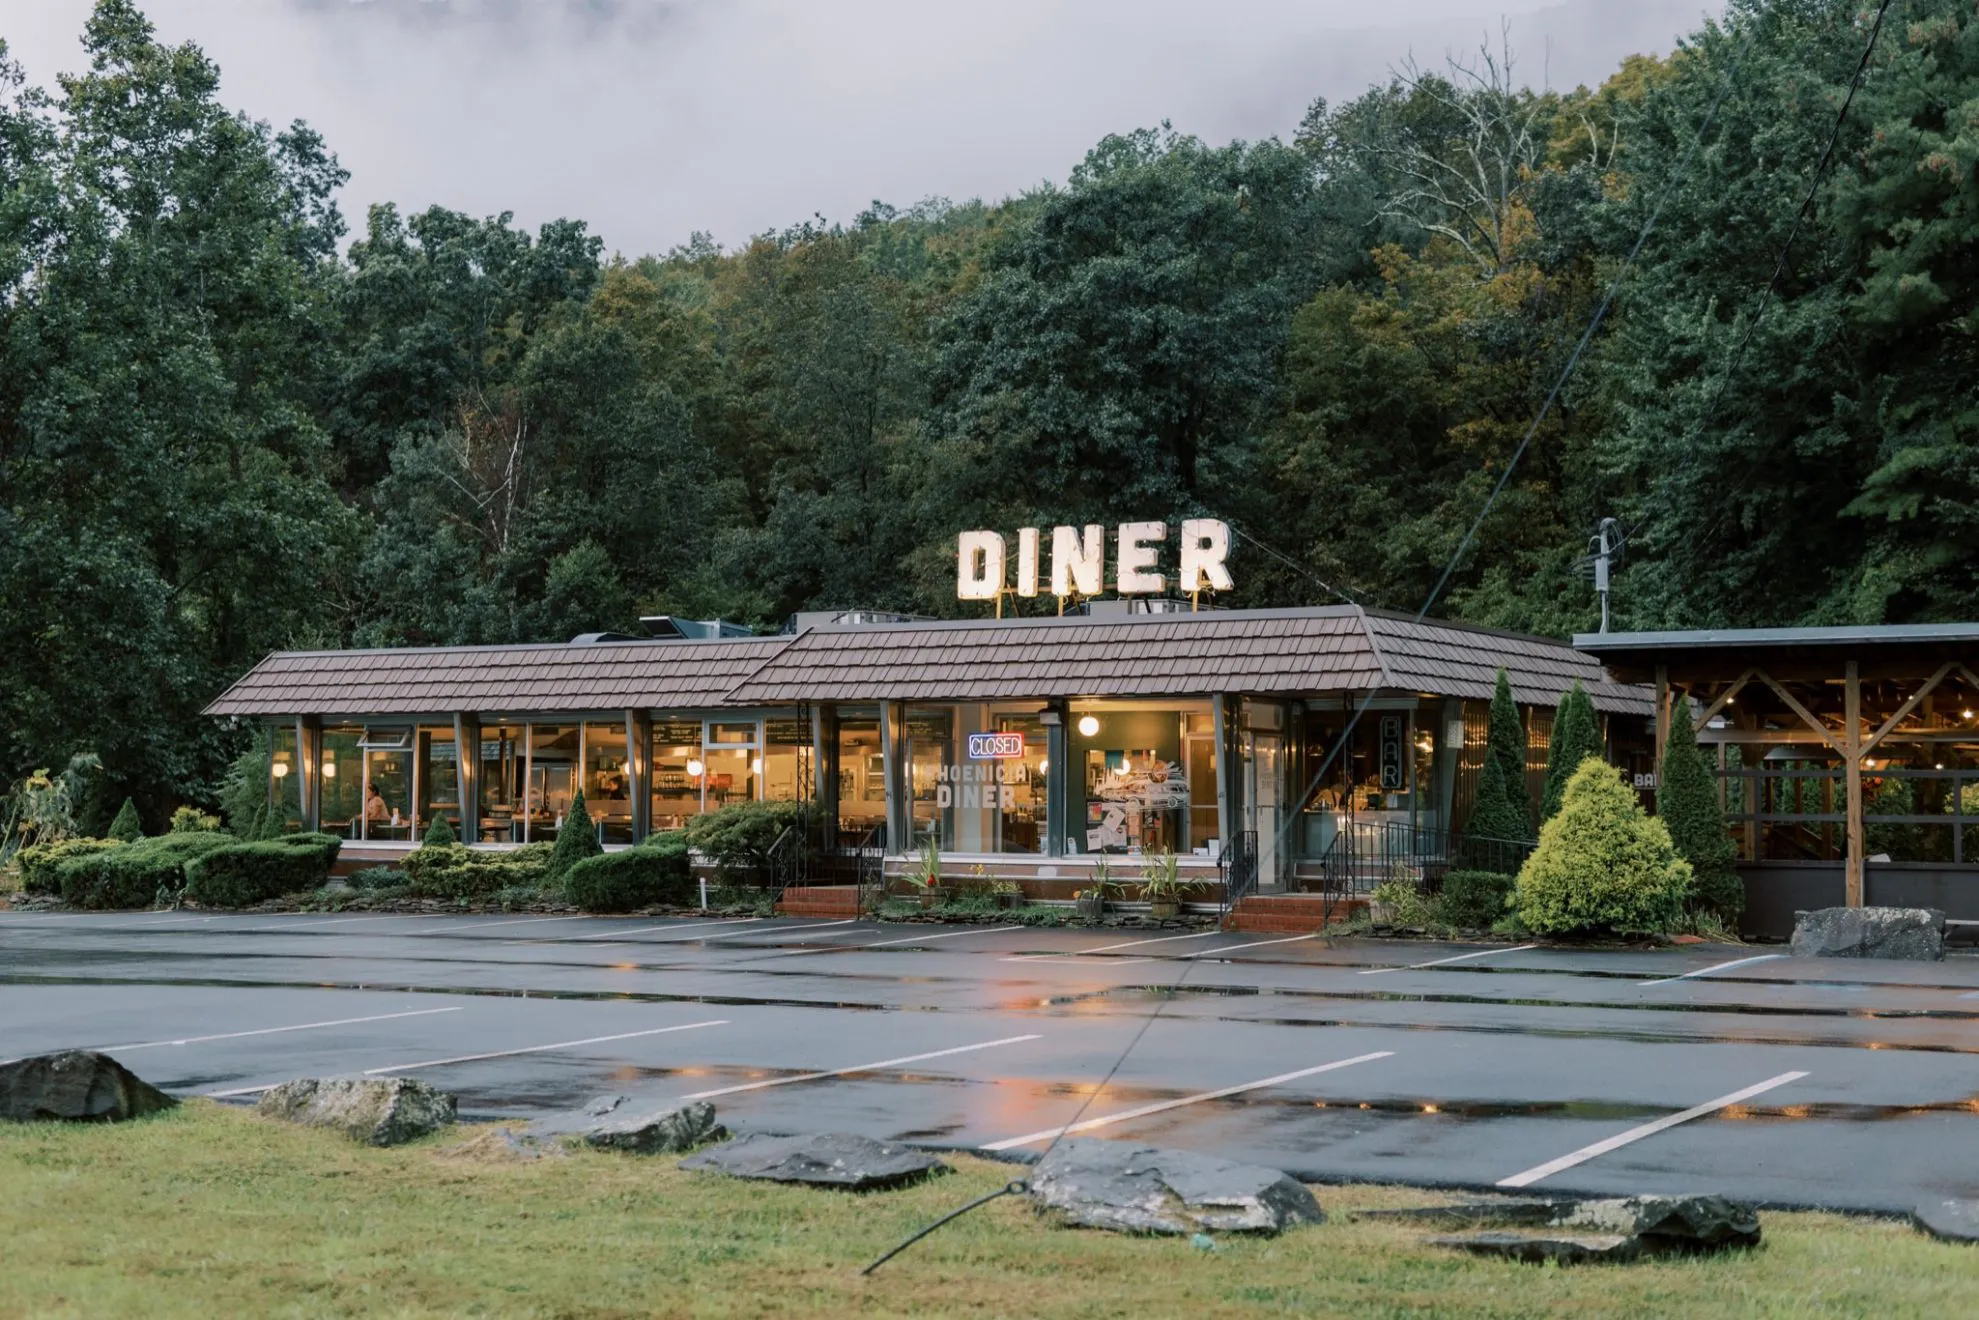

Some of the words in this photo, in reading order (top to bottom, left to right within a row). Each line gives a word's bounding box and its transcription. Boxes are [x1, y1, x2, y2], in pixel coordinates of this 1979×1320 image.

[957, 519, 1235, 600] DINER
[971, 736, 1021, 755] CLOSED
[1383, 719, 1398, 785] BAR
[929, 763, 1026, 782] HOENICIA
[937, 784, 1016, 809] DINER
